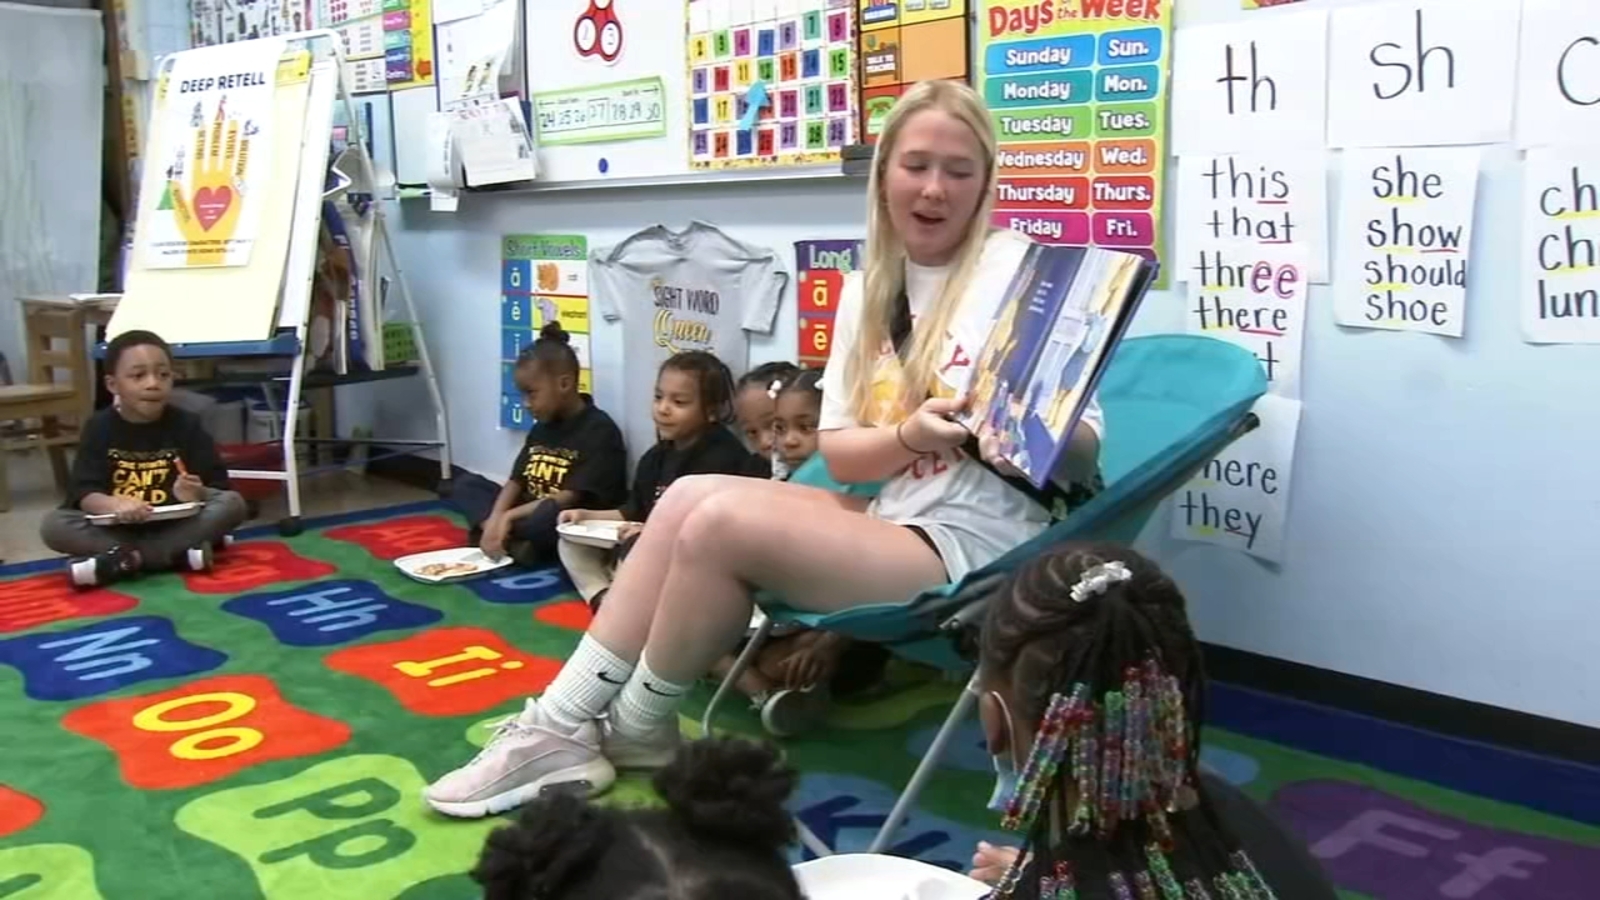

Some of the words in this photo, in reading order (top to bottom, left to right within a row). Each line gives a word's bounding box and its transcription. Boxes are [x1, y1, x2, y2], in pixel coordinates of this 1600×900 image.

[989, 0, 1054, 36] Days
[1005, 46, 1070, 66] Sunday
[1108, 39, 1149, 56] Sun.
[1370, 9, 1454, 100] sh
[180, 78, 214, 93] DEEP
[218, 72, 266, 90] RETELL
[1003, 81, 1070, 100] Monday
[1104, 74, 1148, 92] Mon.
[1216, 40, 1277, 114] th
[1002, 116, 1072, 134] Tuesday
[1100, 112, 1150, 129] Tues.
[1101, 147, 1147, 165] Wed.
[998, 184, 1074, 204] Thursday
[1094, 184, 1151, 200] Thurs.
[1202, 157, 1290, 200] this
[1372, 155, 1444, 200] she
[1010, 218, 1062, 238] Friday
[1106, 219, 1138, 236] Fri.
[1206, 207, 1297, 243] that
[1367, 207, 1463, 248] show
[809, 244, 852, 274] Long
[1194, 251, 1298, 298] three
[1364, 254, 1467, 290] should
[654, 285, 682, 310] SIGHT
[686, 288, 720, 315] WORD
[1194, 296, 1288, 332] there
[1366, 290, 1448, 326] shoe
[1180, 491, 1262, 549] they
[267, 588, 389, 632] Hh
[38, 626, 160, 681] Nn
[392, 645, 524, 688] Ii
[132, 692, 264, 760] Oo
[252, 776, 417, 870] Pp
[1307, 808, 1547, 900] Ff
